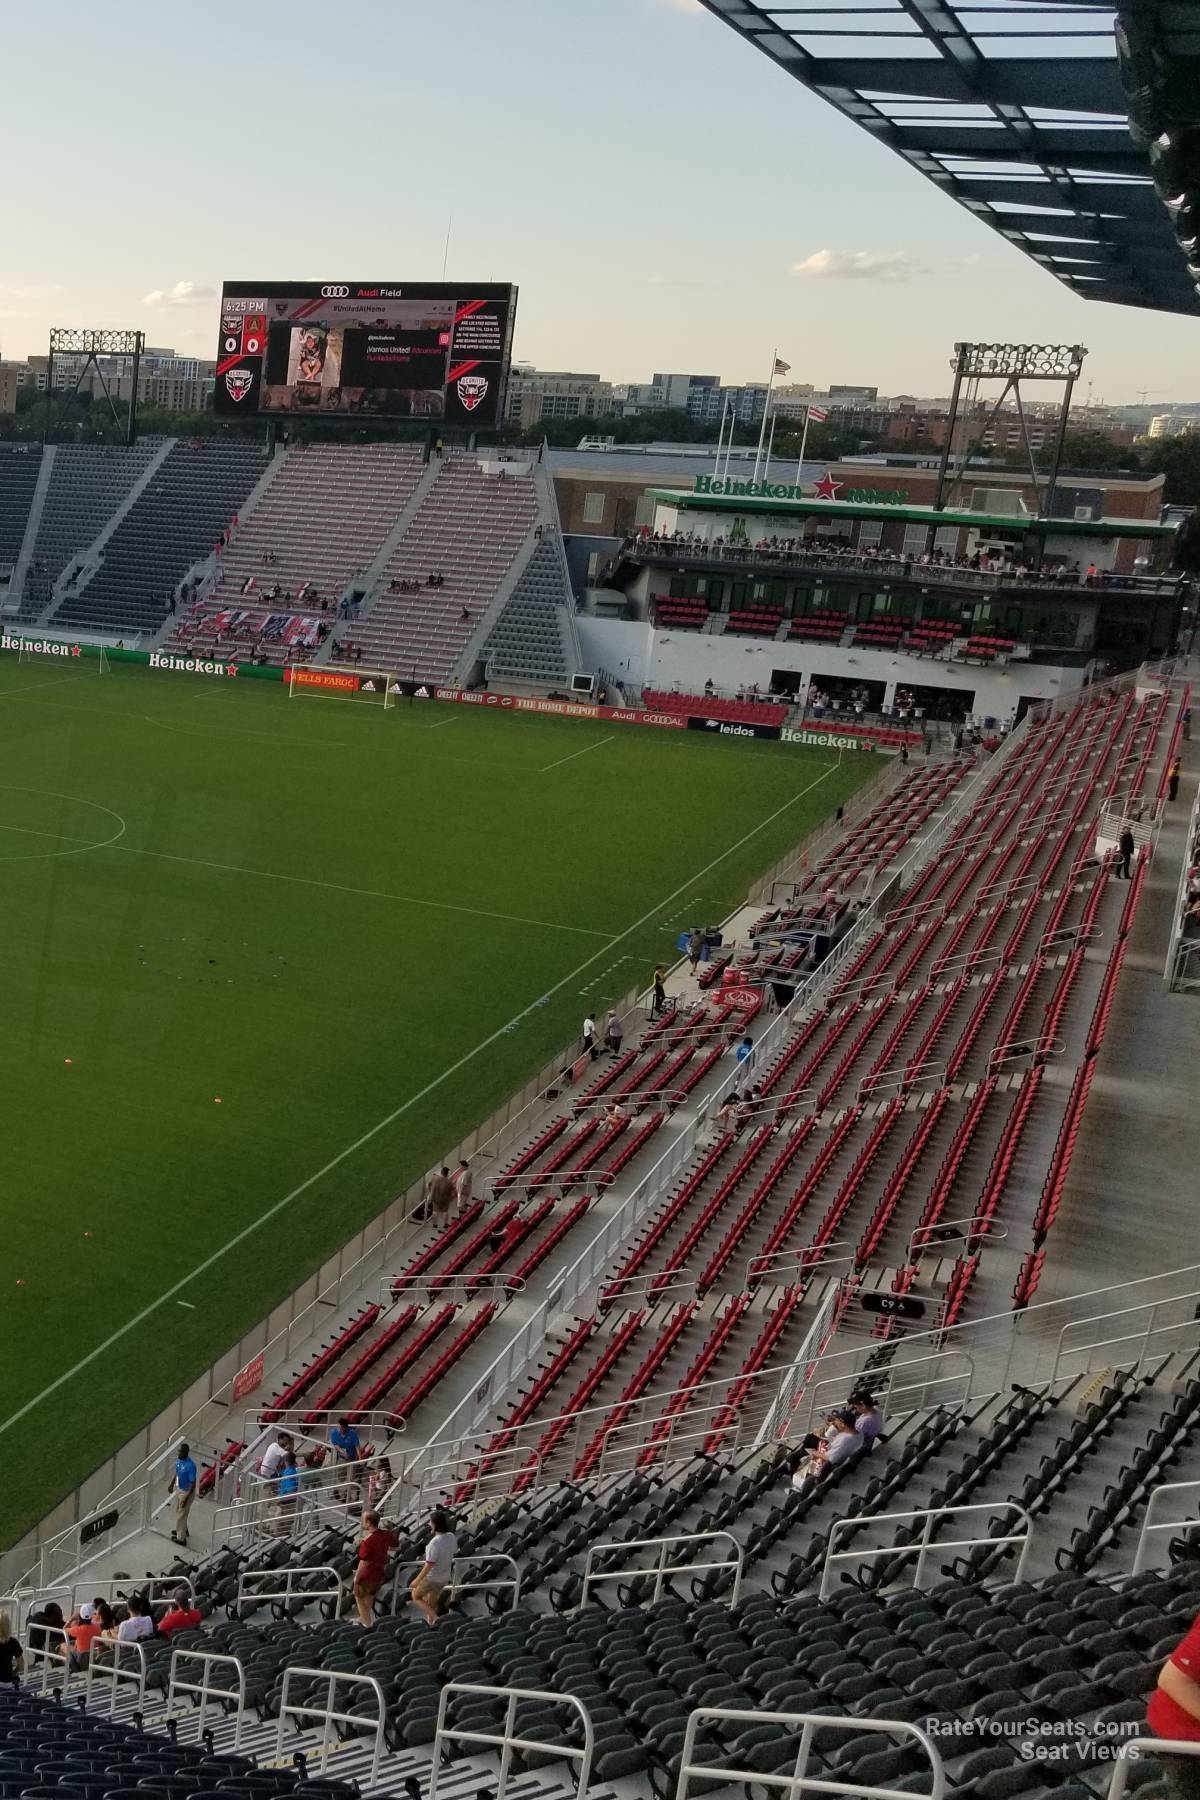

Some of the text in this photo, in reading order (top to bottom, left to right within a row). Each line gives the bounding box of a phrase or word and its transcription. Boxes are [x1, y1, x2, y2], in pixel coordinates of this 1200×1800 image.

[357, 289, 402, 297] Audi Field
[226, 302, 264, 312] 6:25 PM
[225, 338, 237, 352] 0
[247, 338, 259, 353] 0
[389, 346, 411, 354] United!
[695, 475, 802, 500] Heineken
[0, 635, 70, 657] Heineken
[149, 653, 224, 676] Heineken
[516, 698, 599, 717] THE HOME DEPOT
[611, 711, 636, 721] Audi
[719, 723, 755, 737] leidos
[780, 727, 858, 750] Heineken
[881, 1299, 895, 1309] C9
